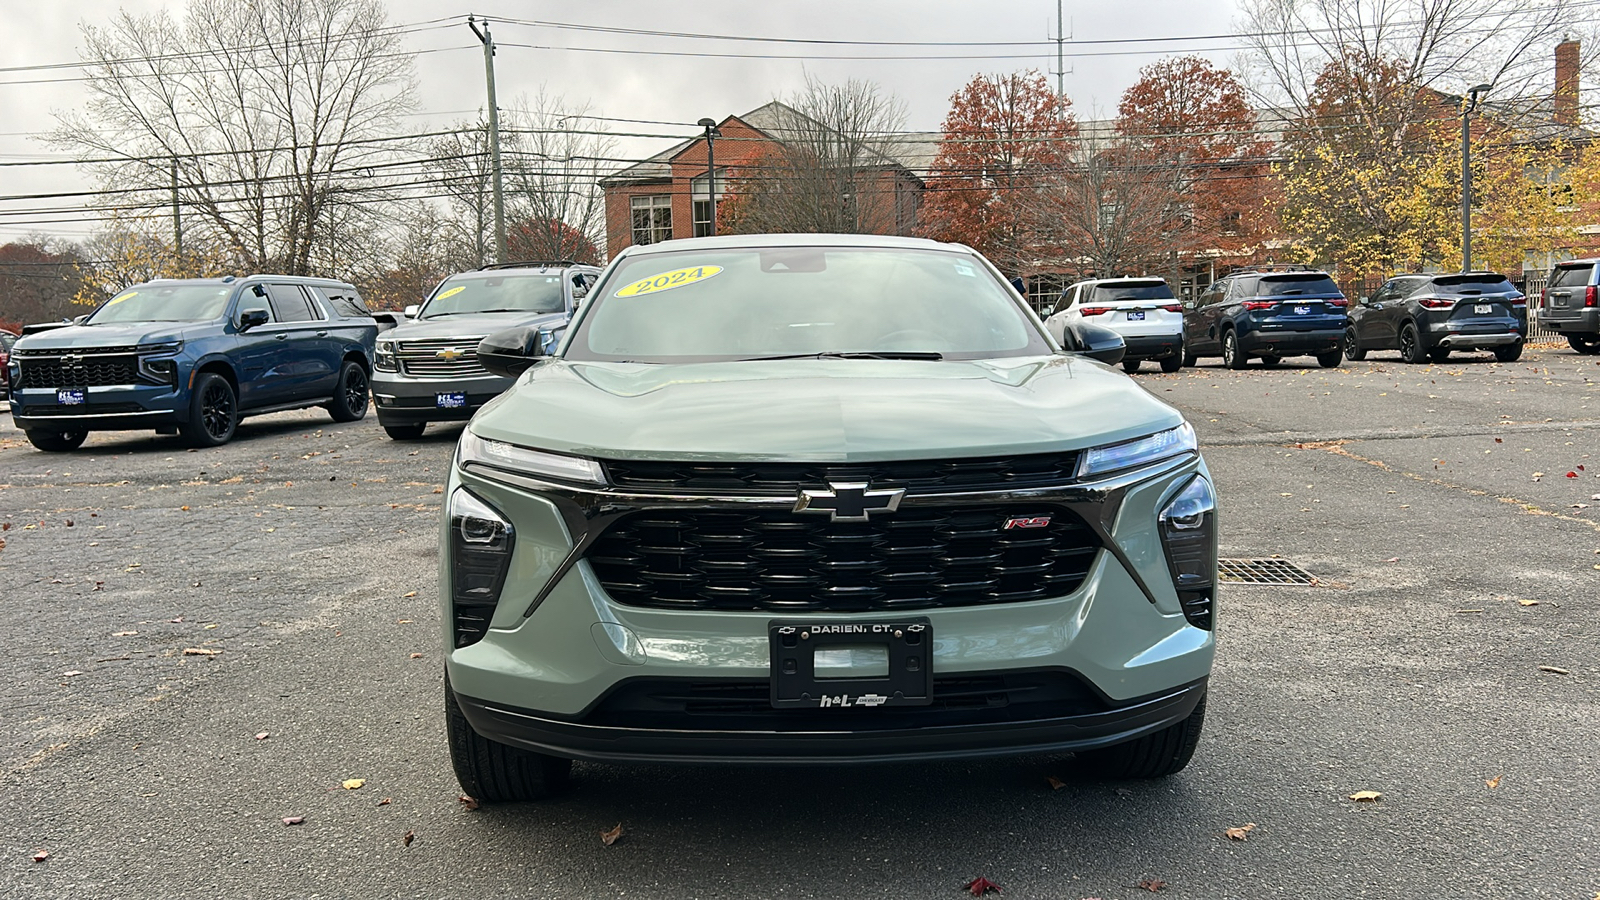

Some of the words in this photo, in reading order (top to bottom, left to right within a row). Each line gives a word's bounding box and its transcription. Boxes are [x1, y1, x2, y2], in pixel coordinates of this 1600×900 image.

[635, 267, 706, 294] 2024
[1003, 516, 1052, 530] RS
[811, 625, 867, 634] DARIEN,
[872, 624, 893, 633] CT.
